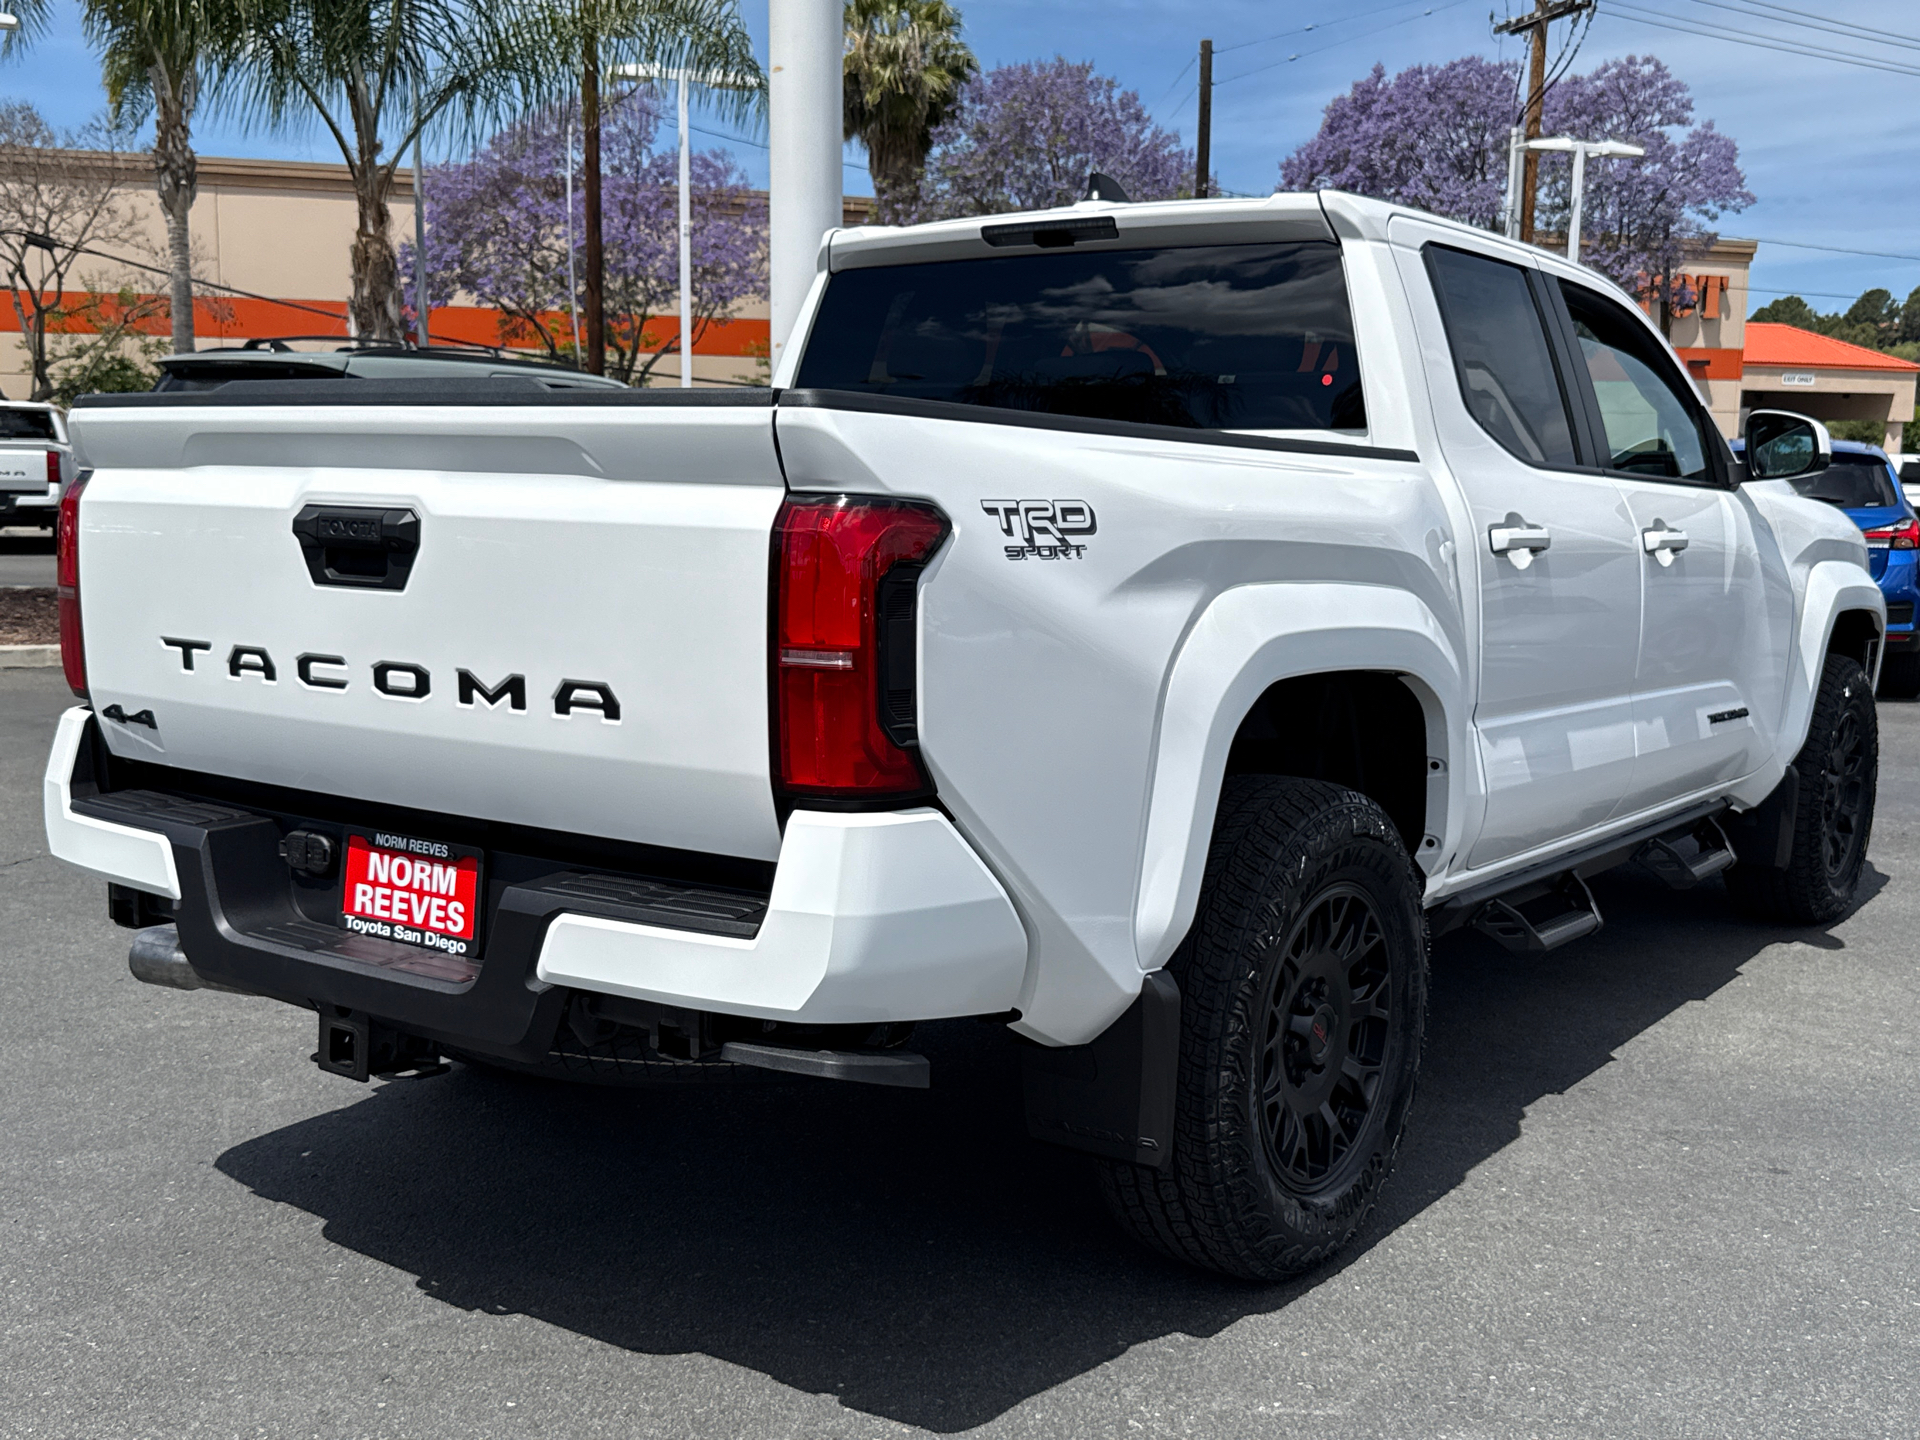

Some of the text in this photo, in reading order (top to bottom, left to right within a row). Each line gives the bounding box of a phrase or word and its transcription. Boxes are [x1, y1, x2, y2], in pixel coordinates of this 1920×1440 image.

[320, 519, 379, 538] TOYOTA
[980, 499, 1098, 546] TRD
[1004, 544, 1087, 561] SPORT
[160, 636, 621, 722] TACOMA
[375, 832, 449, 858] NORM REEVES
[367, 852, 457, 896] NORM
[353, 882, 465, 933] REEVES
[344, 915, 467, 954] Toyota San Diego
